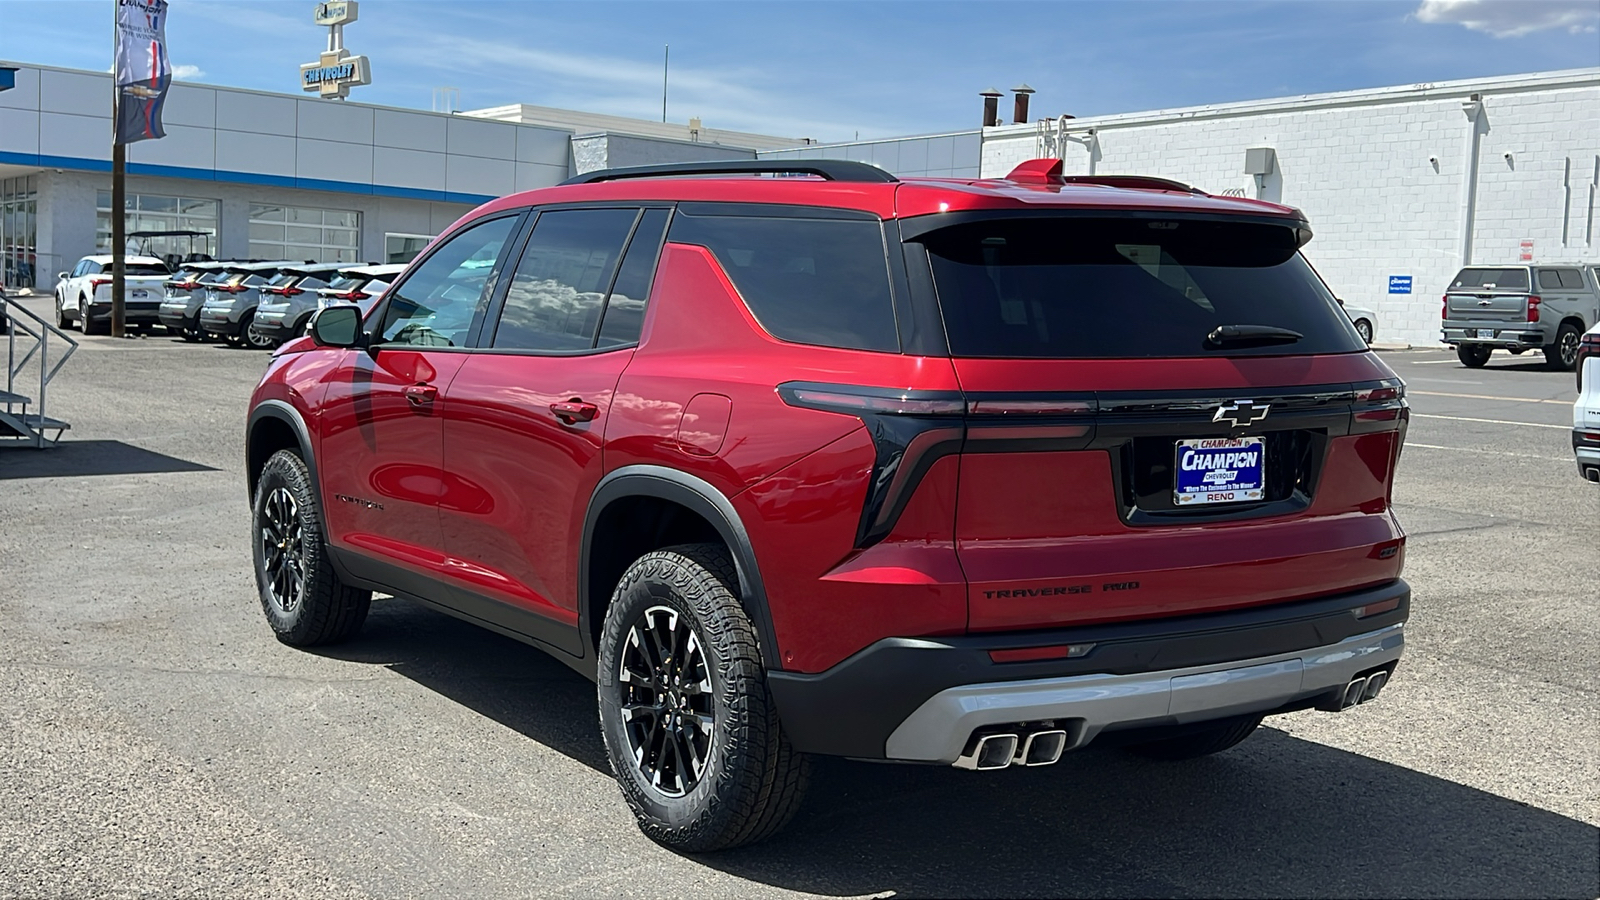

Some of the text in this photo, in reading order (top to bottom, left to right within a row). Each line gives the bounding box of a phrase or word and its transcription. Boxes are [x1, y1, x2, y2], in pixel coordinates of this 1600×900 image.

[303, 63, 354, 83] CHEVROLET
[1201, 439, 1243, 448] CHAMPION
[1181, 450, 1258, 471] CHAMPION
[1205, 472, 1236, 480] CHEVROLET
[1207, 493, 1235, 501] RENO
[983, 585, 1092, 599] TRAVERSE
